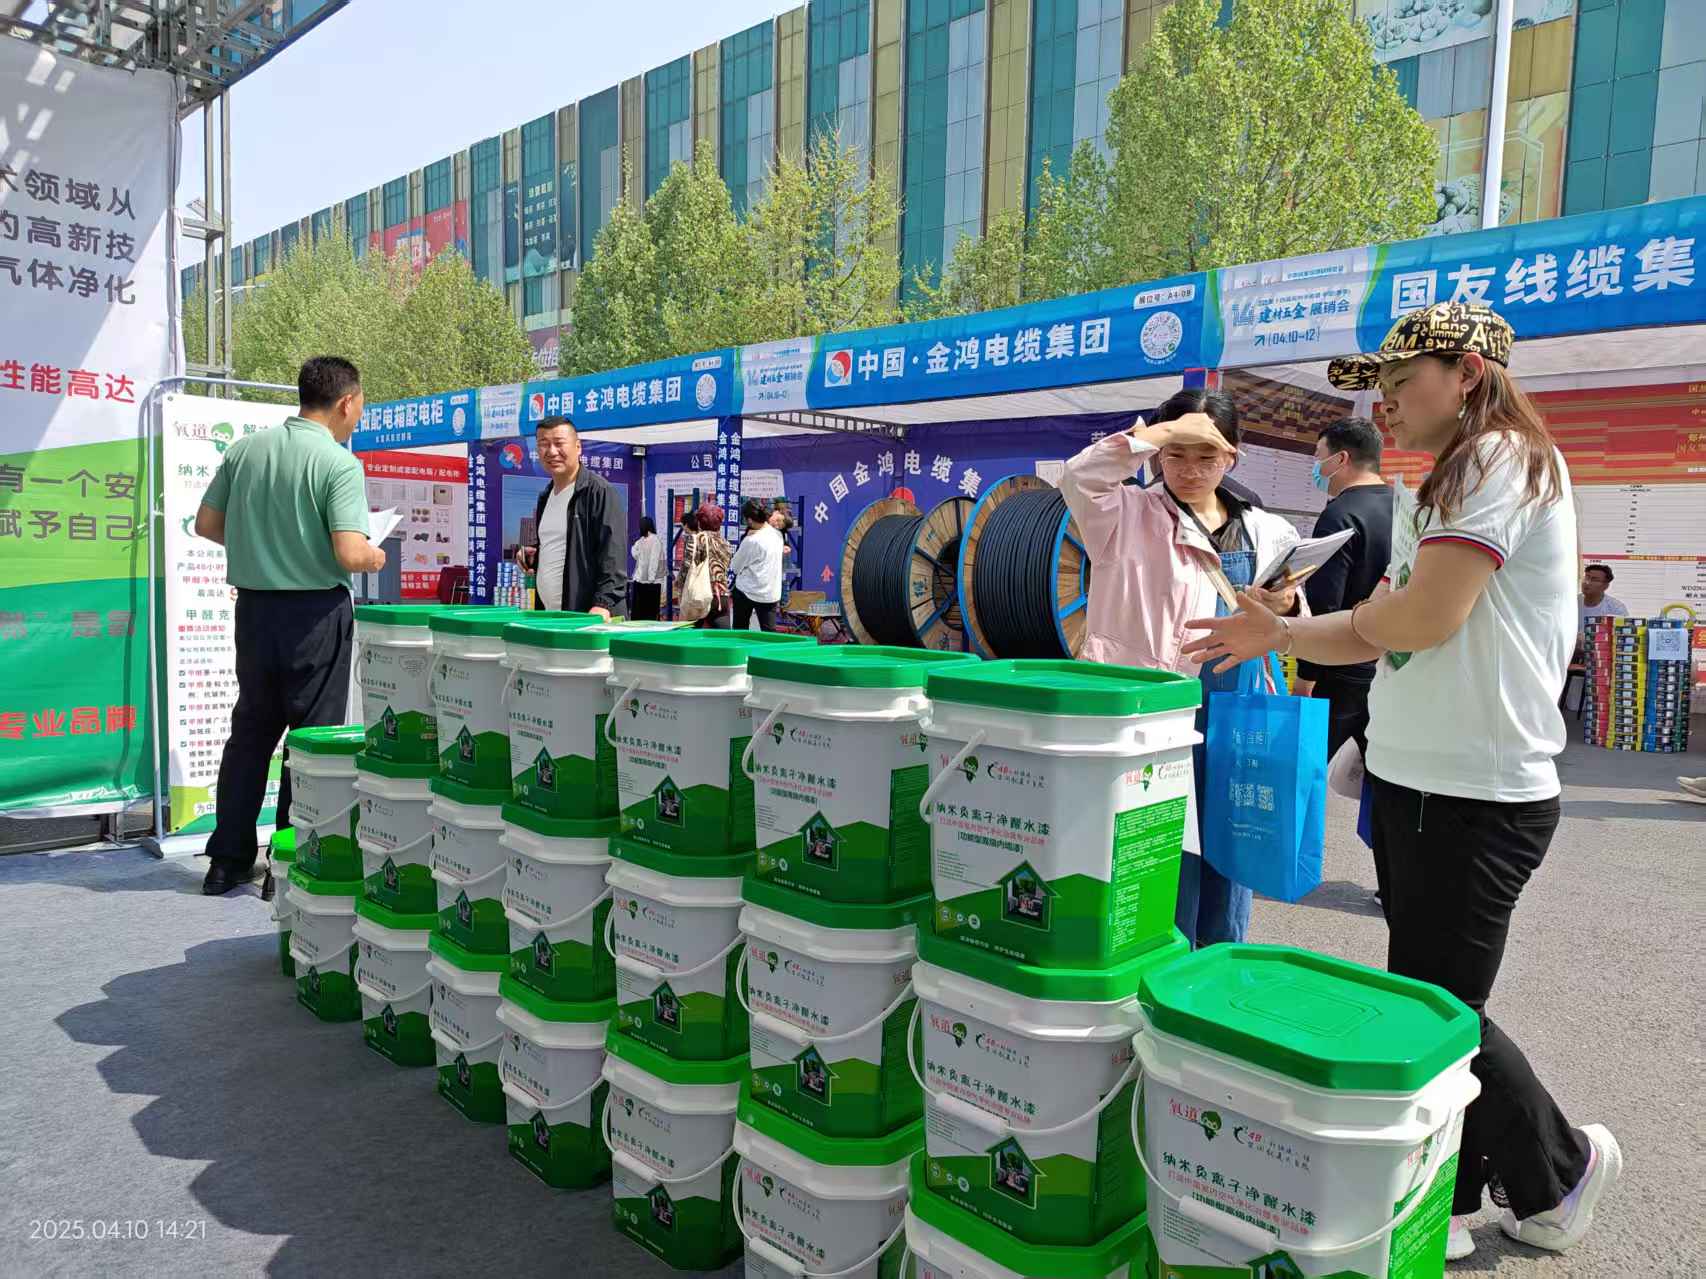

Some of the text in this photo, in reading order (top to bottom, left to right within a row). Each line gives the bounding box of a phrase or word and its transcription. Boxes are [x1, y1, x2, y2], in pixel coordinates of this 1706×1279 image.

[1390, 236, 1697, 319] 国友线缆集
